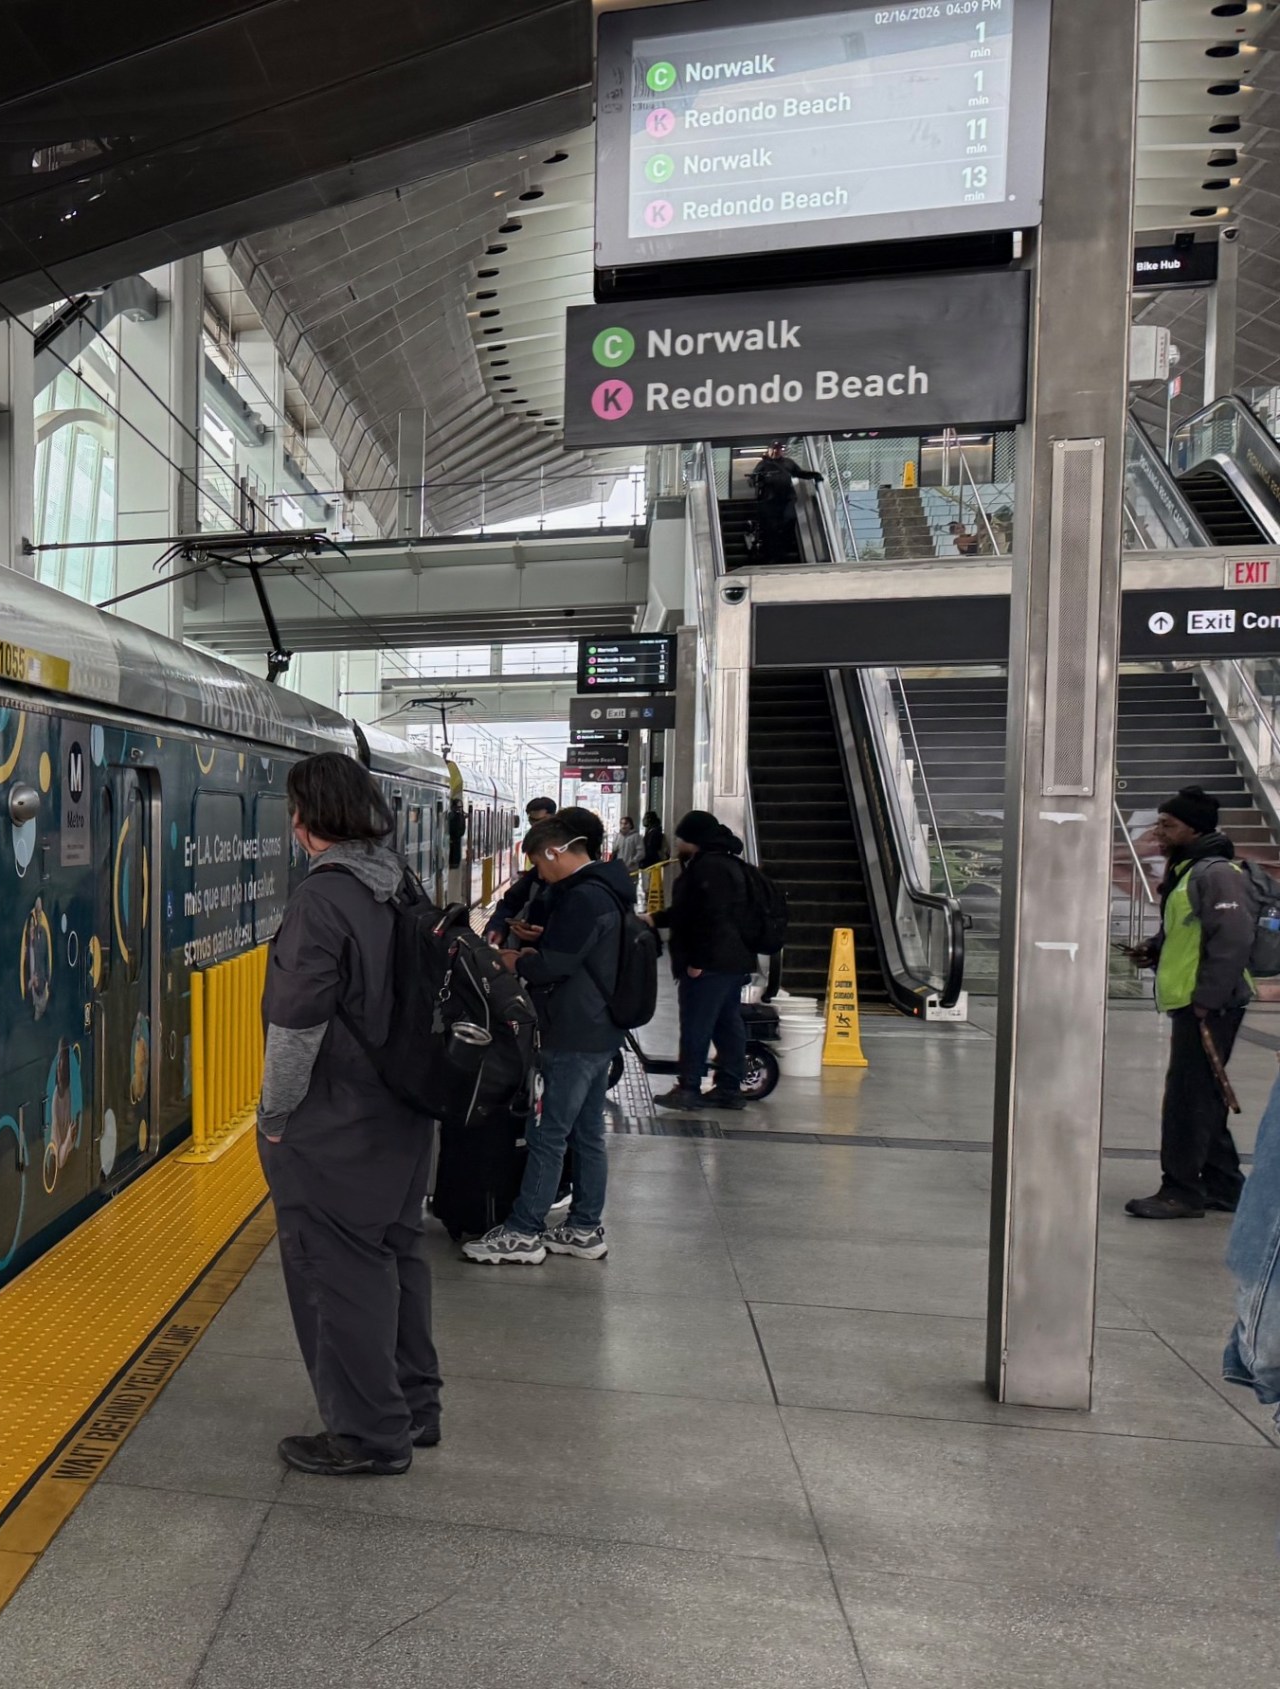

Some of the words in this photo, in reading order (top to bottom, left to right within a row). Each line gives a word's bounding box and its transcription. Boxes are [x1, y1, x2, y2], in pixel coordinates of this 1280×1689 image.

[875, 5, 941, 25] 02/16/2026
[946, 1, 978, 15] 04:09
[981, 0, 1001, 11] PM
[975, 22, 986, 43] 1
[970, 48, 991, 58] min
[654, 69, 669, 85] C
[686, 54, 775, 82] Norwalk
[974, 70, 984, 92] 1
[654, 114, 669, 132] K
[685, 102, 777, 128] Redondo
[783, 92, 851, 117] Beach
[968, 96, 989, 106] min
[966, 118, 987, 140] 11
[966, 144, 987, 154] min
[652, 160, 667, 177] C
[683, 148, 773, 175] Norwalk
[962, 166, 987, 188] 13
[652, 205, 667, 222] K
[683, 195, 774, 220] Redondo
[781, 186, 848, 210] Beach
[964, 192, 985, 201] min
[1136, 262, 1159, 271] Bike
[1160, 260, 1181, 270] Hub
[604, 335, 623, 359] C
[647, 319, 801, 358] Norwalk
[603, 386, 623, 412] K
[647, 374, 803, 411] Redondo
[815, 365, 929, 400] Beach
[1235, 562, 1271, 584] EXIT
[1191, 613, 1232, 630] Exit
[0, 641, 25, 679] 1055
[607, 709, 625, 718] Exit
[70, 753, 82, 792] M
[67, 811, 85, 828] Metro
[198, 836, 212, 865] L.A.
[214, 834, 231, 863] Care
[262, 836, 281, 857] somos
[203, 885, 219, 918] que
[220, 885, 231, 907] un
[184, 936, 212, 966] somos
[212, 925, 233, 962] parte
[51, 1443, 110, 1480] WAIT
[82, 1394, 147, 1442] BEHIND
[120, 1347, 183, 1391] YELLOW
[158, 1324, 201, 1348] LINE
